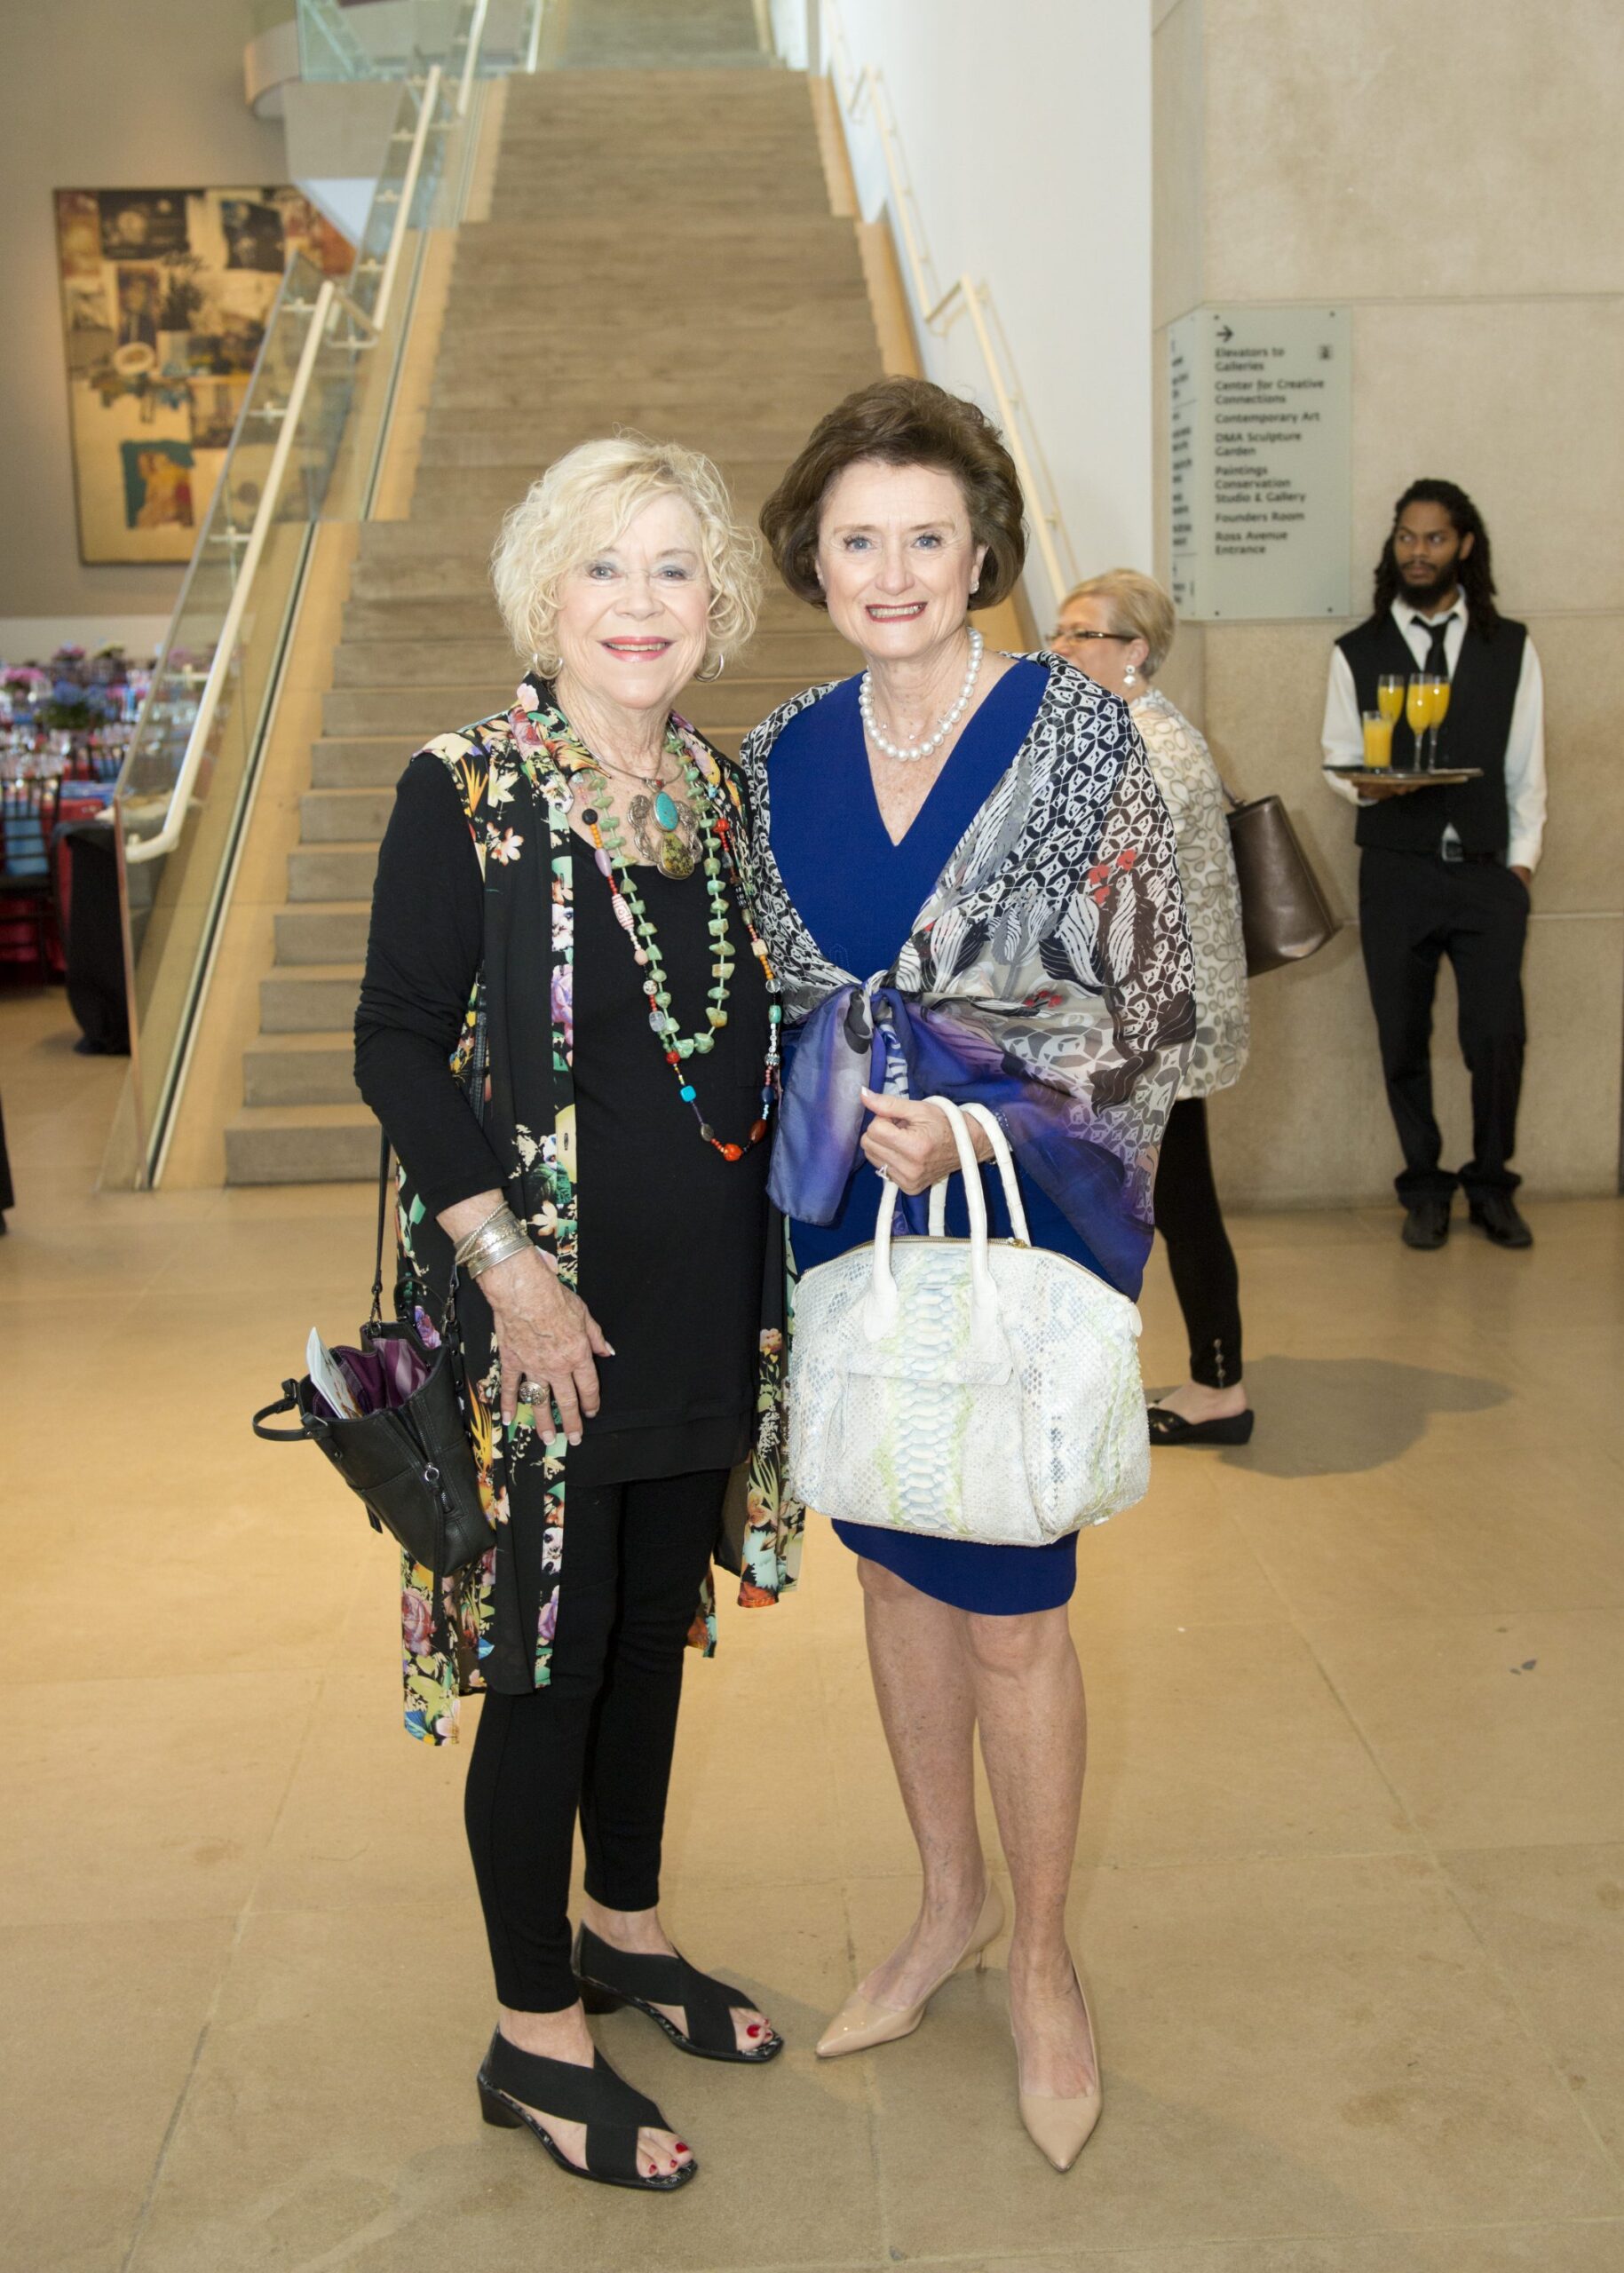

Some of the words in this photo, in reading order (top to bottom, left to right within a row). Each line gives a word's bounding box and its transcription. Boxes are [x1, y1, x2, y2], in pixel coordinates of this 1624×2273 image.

[1215, 347, 1268, 358] Elevators
[1271, 346, 1285, 356] to
[1215, 361, 1264, 372] Galleries
[1215, 381, 1252, 391] Center
[1256, 379, 1273, 391] for
[1277, 378, 1325, 389] Creative
[1215, 394, 1287, 405] Connections
[1215, 413, 1298, 424] Contemporary
[1302, 411, 1321, 422] Art
[1215, 433, 1243, 443] DMA
[1248, 432, 1302, 443] Sculpture
[1215, 447, 1256, 456] Garden
[1215, 466, 1268, 477] Paintings
[1215, 479, 1291, 490] Conservation
[1215, 493, 1251, 503] Studio
[1255, 493, 1262, 503] &
[1265, 492, 1307, 503] Gallery
[1215, 512, 1268, 523] Founders
[1271, 511, 1305, 521] Room
[1215, 532, 1242, 542] Ross
[1246, 531, 1288, 541] Avenue
[1215, 545, 1266, 556] Entrance
